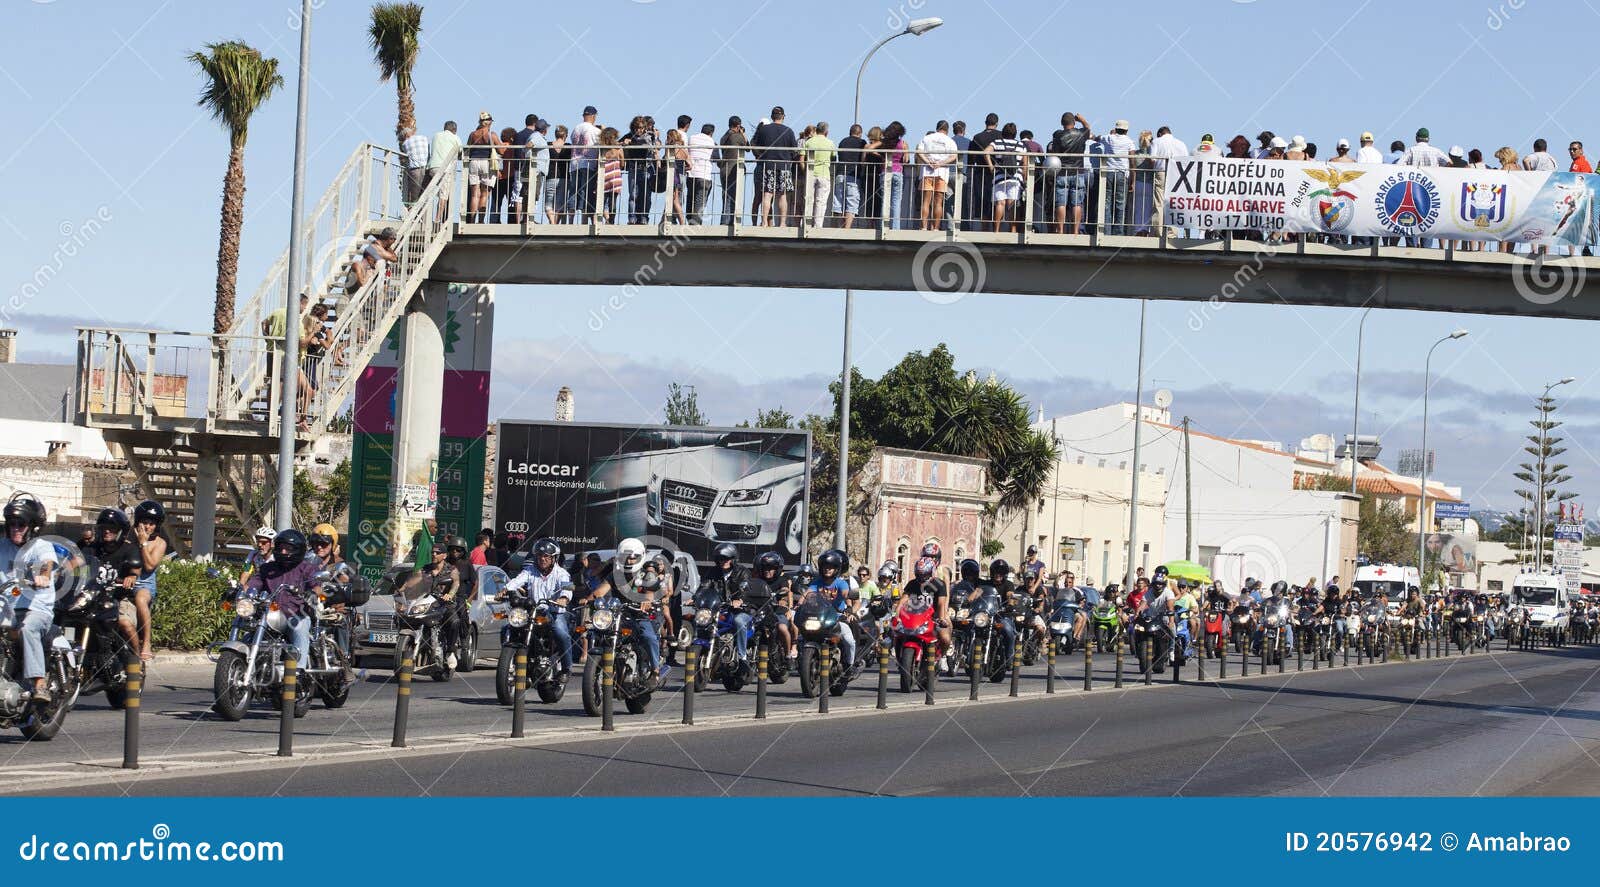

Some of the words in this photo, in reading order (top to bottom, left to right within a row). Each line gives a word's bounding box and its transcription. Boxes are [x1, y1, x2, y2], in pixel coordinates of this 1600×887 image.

[1171, 161, 1203, 194] XI
[1207, 160, 1266, 178] TROFÉU
[1271, 168, 1285, 178] DO
[1206, 179, 1286, 196] GUADIANA
[1291, 180, 1311, 208] 20:45H
[1375, 176, 1398, 204] PARIS
[1408, 172, 1440, 209] GERMAIN
[1169, 195, 1223, 211] ESTÁDIO
[1226, 199, 1285, 214] ALGARVE
[1169, 213, 1184, 226] 15
[1197, 214, 1213, 227] 16
[1224, 215, 1241, 228] 17
[1244, 216, 1284, 230] JULHO
[1375, 206, 1415, 236] FOOTBALL
[1418, 210, 1440, 233] CLUB
[508, 458, 580, 477] Lacocar
[508, 477, 514, 485] O
[515, 478, 528, 486] seu
[530, 478, 585, 489] concessionário
